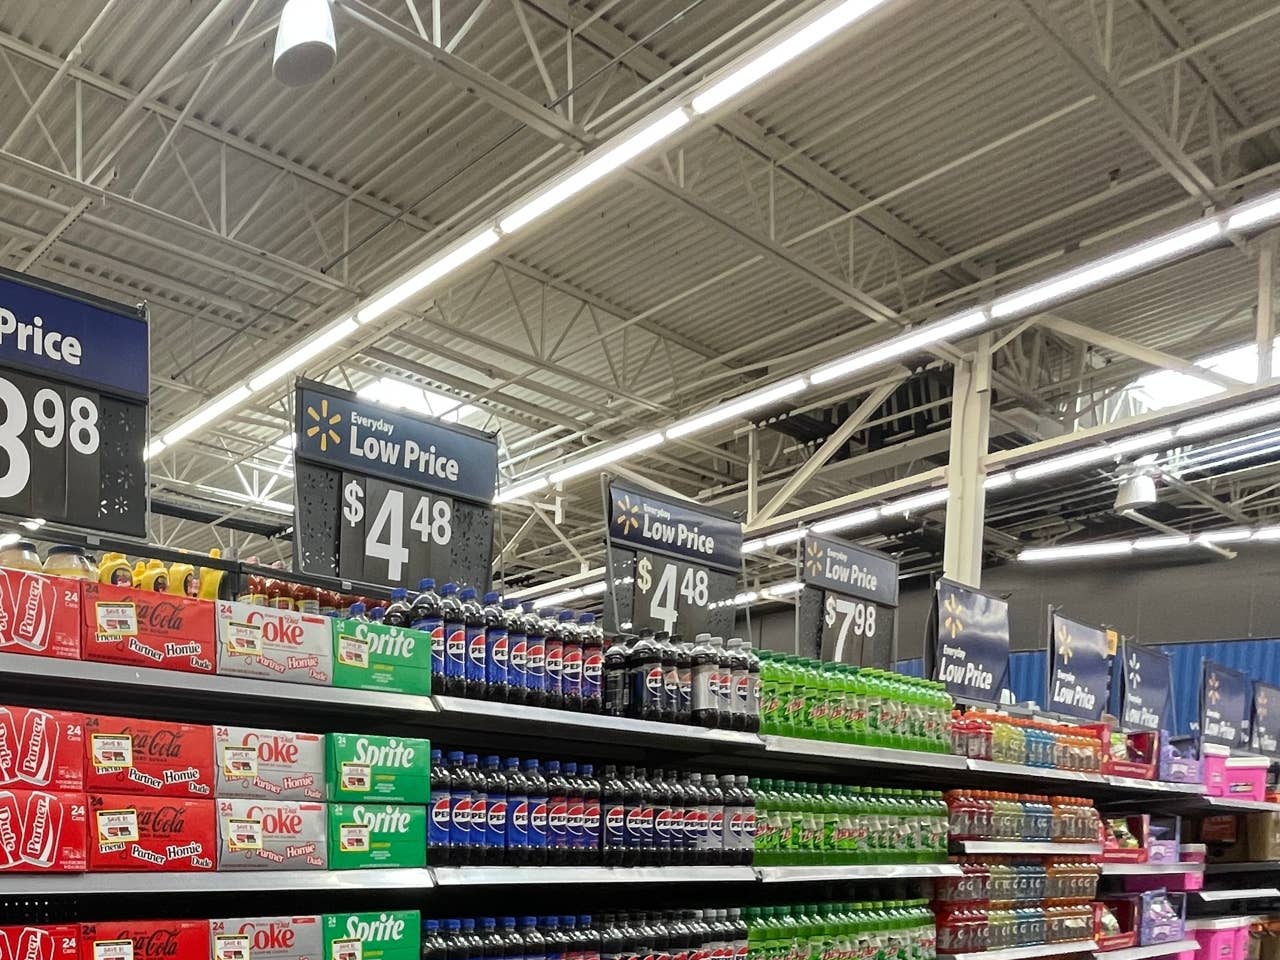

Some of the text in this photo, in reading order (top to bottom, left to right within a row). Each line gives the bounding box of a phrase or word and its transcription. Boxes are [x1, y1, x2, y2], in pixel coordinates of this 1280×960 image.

[351, 411, 394, 436] Everyday
[349, 431, 459, 481] Low Price
[643, 504, 671, 520] Everyday
[642, 514, 714, 554] Low Price
[826, 557, 878, 591] Low Price
[20, 580, 42, 636] Partner
[64, 591, 78, 602] 24
[221, 605, 232, 613] 24
[129, 638, 163, 660] Partner
[165, 641, 201, 656] Homie
[355, 625, 415, 657] Sprite
[191, 657, 211, 670] Dude
[288, 656, 319, 669] Homie
[939, 658, 993, 690] Low Price
[1054, 681, 1095, 710] Low Price
[23, 716, 44, 772] Partner
[356, 739, 415, 767] Sprite
[164, 768, 199, 784] Homie
[70, 807, 85, 817] 24
[353, 805, 410, 834] Sprite
[345, 915, 404, 942] Sprite
